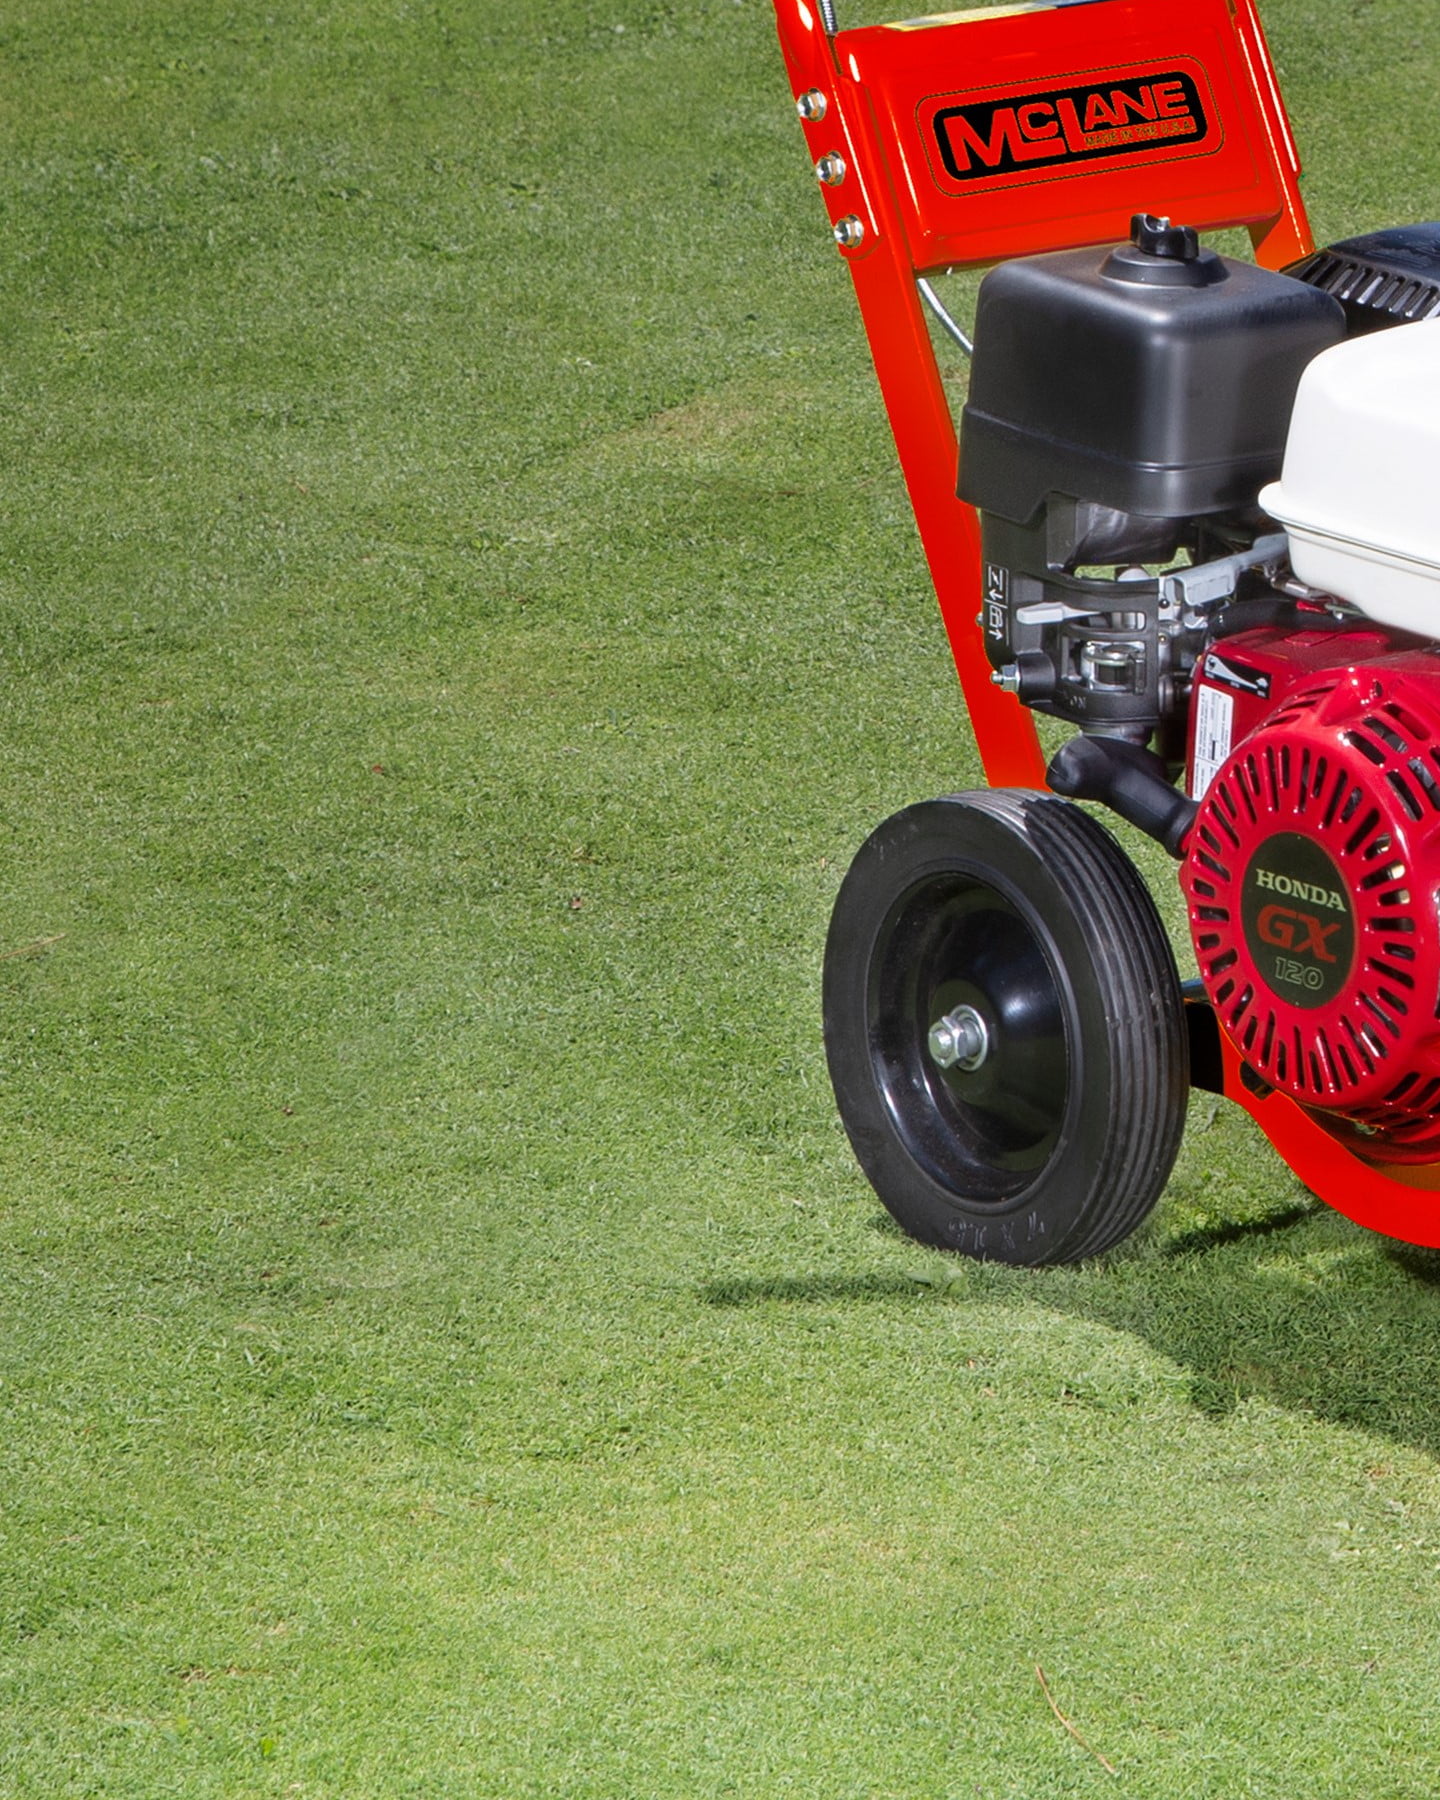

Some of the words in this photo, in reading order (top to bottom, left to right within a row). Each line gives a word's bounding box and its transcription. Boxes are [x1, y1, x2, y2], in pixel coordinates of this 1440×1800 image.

[1255, 868, 1346, 912] HONDA
[1257, 904, 1341, 963] GX
[1275, 957, 1324, 990] 120
